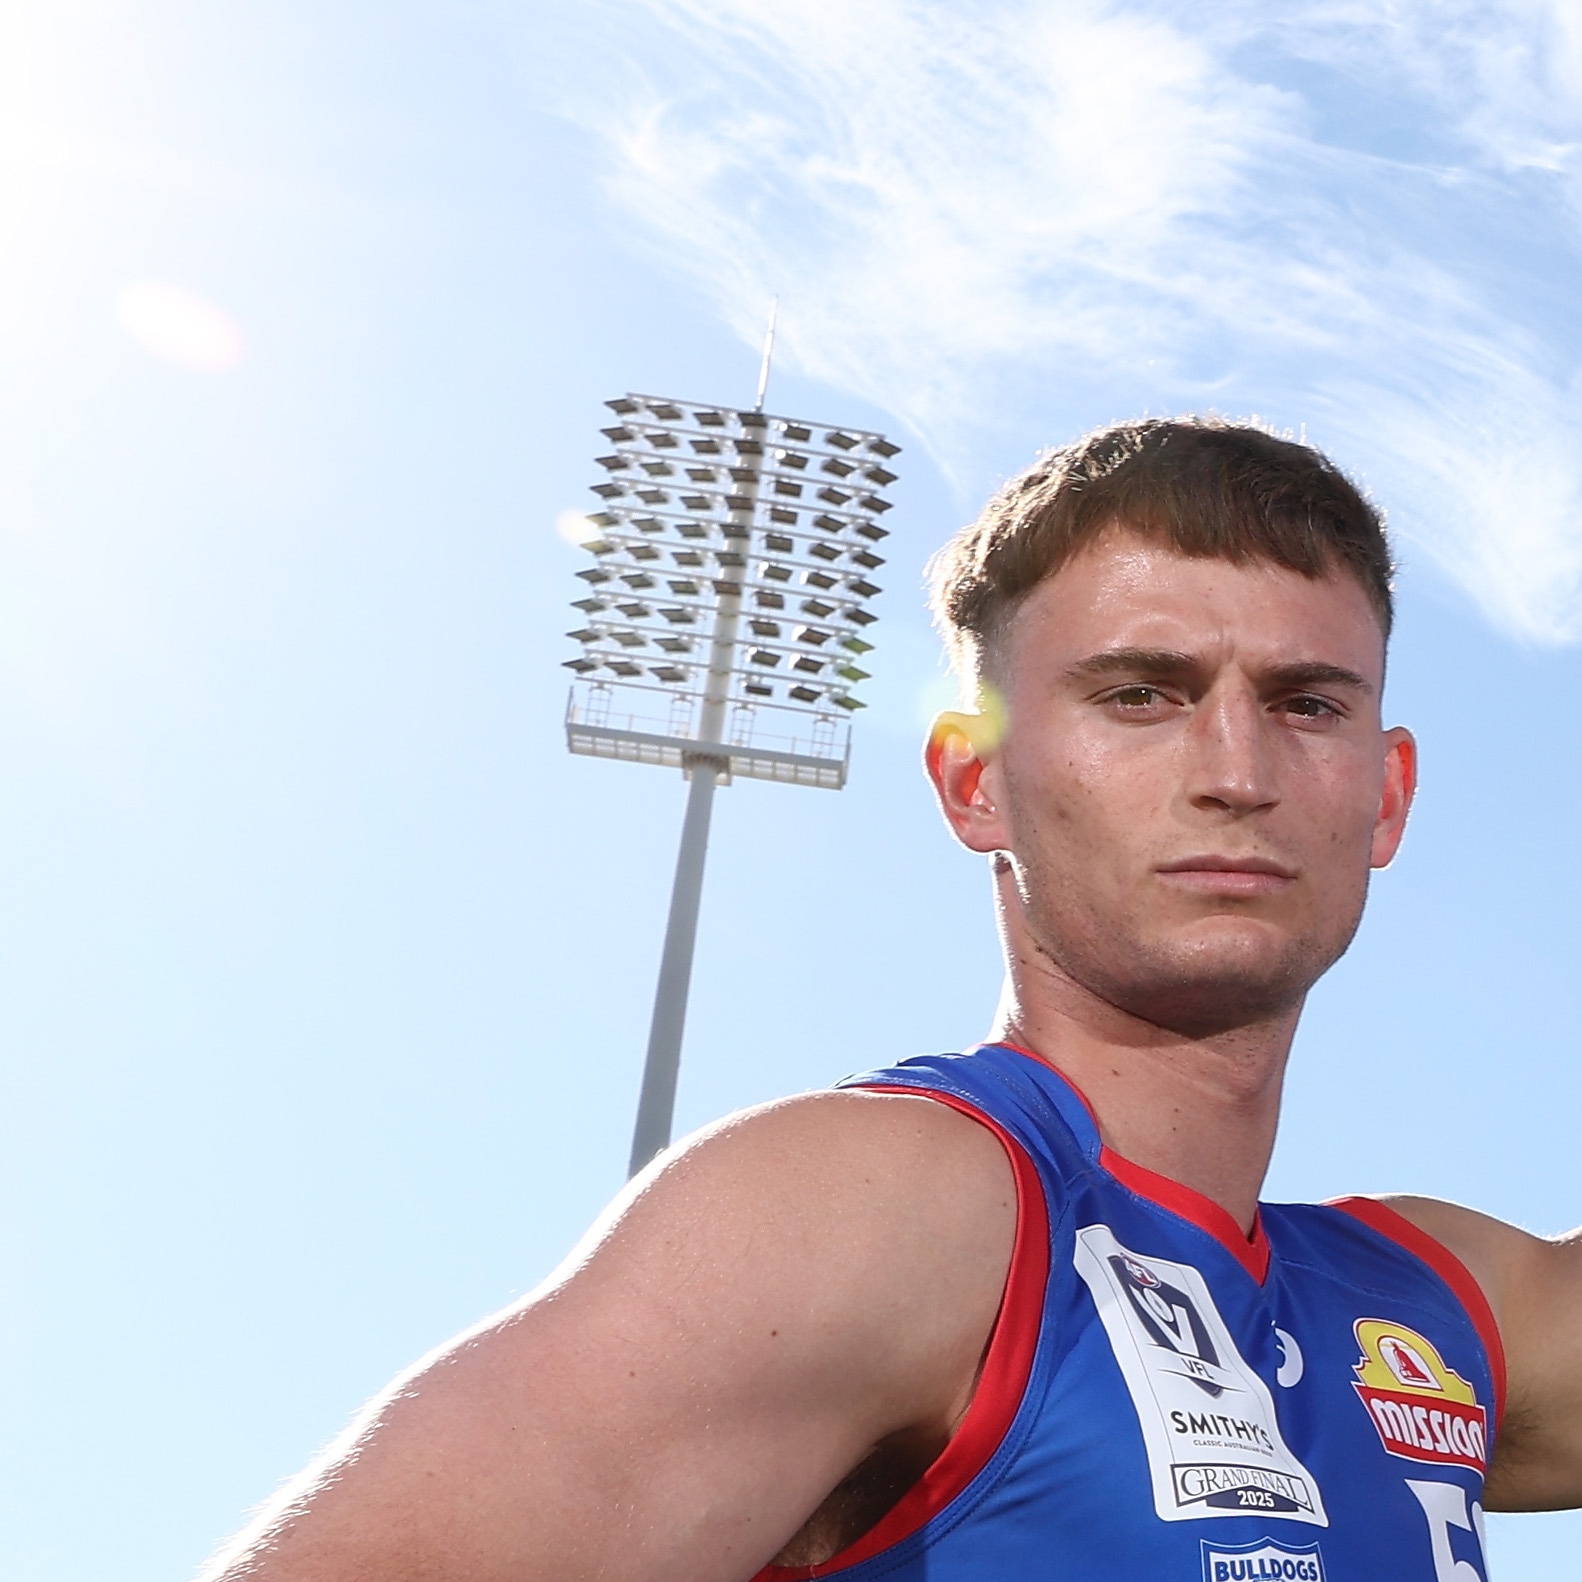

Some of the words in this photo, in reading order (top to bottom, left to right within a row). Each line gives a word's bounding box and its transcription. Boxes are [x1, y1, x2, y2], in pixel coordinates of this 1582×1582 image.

[1180, 1357, 1215, 1381] VFL
[1170, 1410, 1275, 1451] SMITHY'S
[1193, 1439, 1223, 1448] CLASSIC
[1180, 1467, 1250, 1497] GRAND
[1252, 1470, 1309, 1506] FINAL
[1237, 1490, 1275, 1507] 2025
[1214, 1558, 1319, 1582] BULLDOGS
